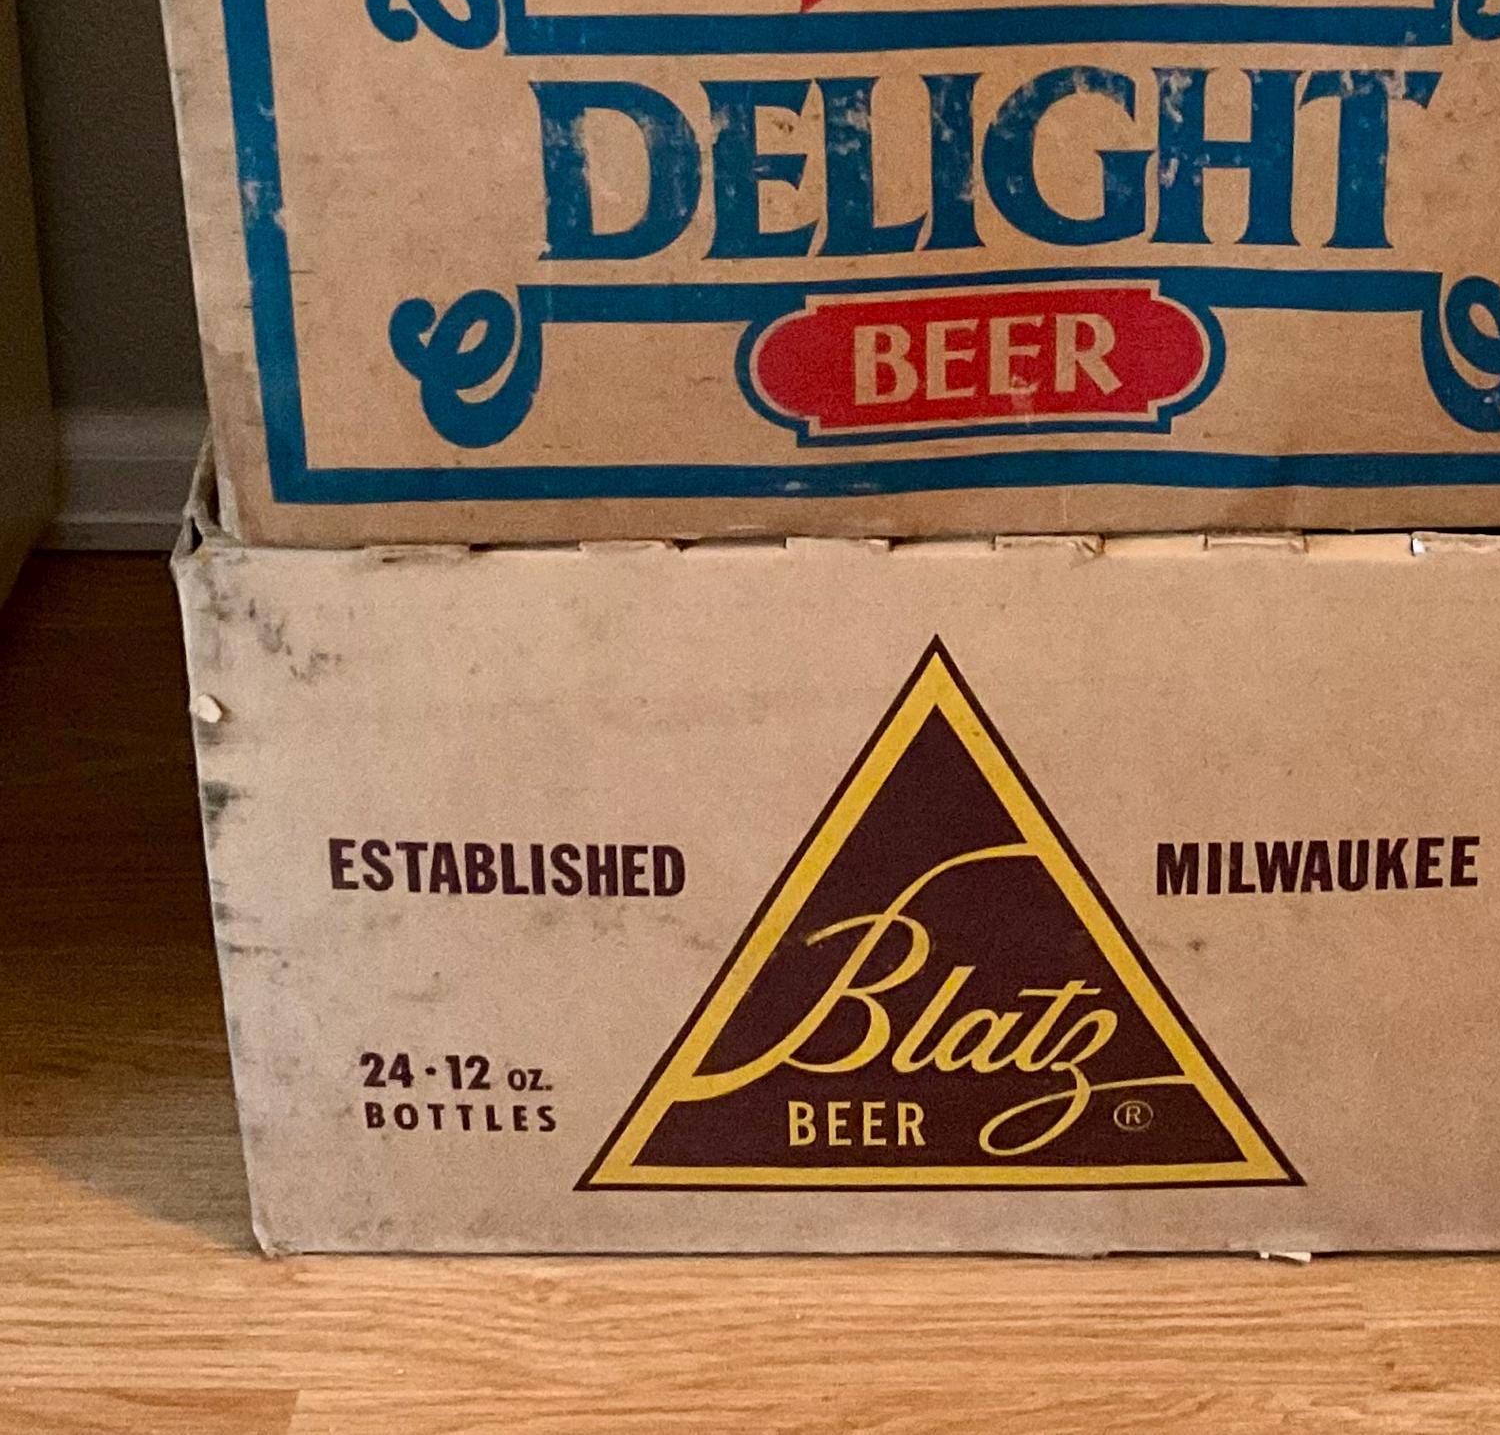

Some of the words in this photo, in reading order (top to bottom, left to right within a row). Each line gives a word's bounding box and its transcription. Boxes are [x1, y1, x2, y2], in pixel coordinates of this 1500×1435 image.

[528, 66, 1443, 261] DELIGHT
[852, 313, 1124, 407] BEER
[328, 838, 686, 897] ESTABLISHED
[1157, 836, 1480, 895] MILWAUKEE
[720, 845, 1180, 1155] Blatz
[364, 1101, 556, 1132] BOTTLES
[788, 1100, 925, 1146] BEER
